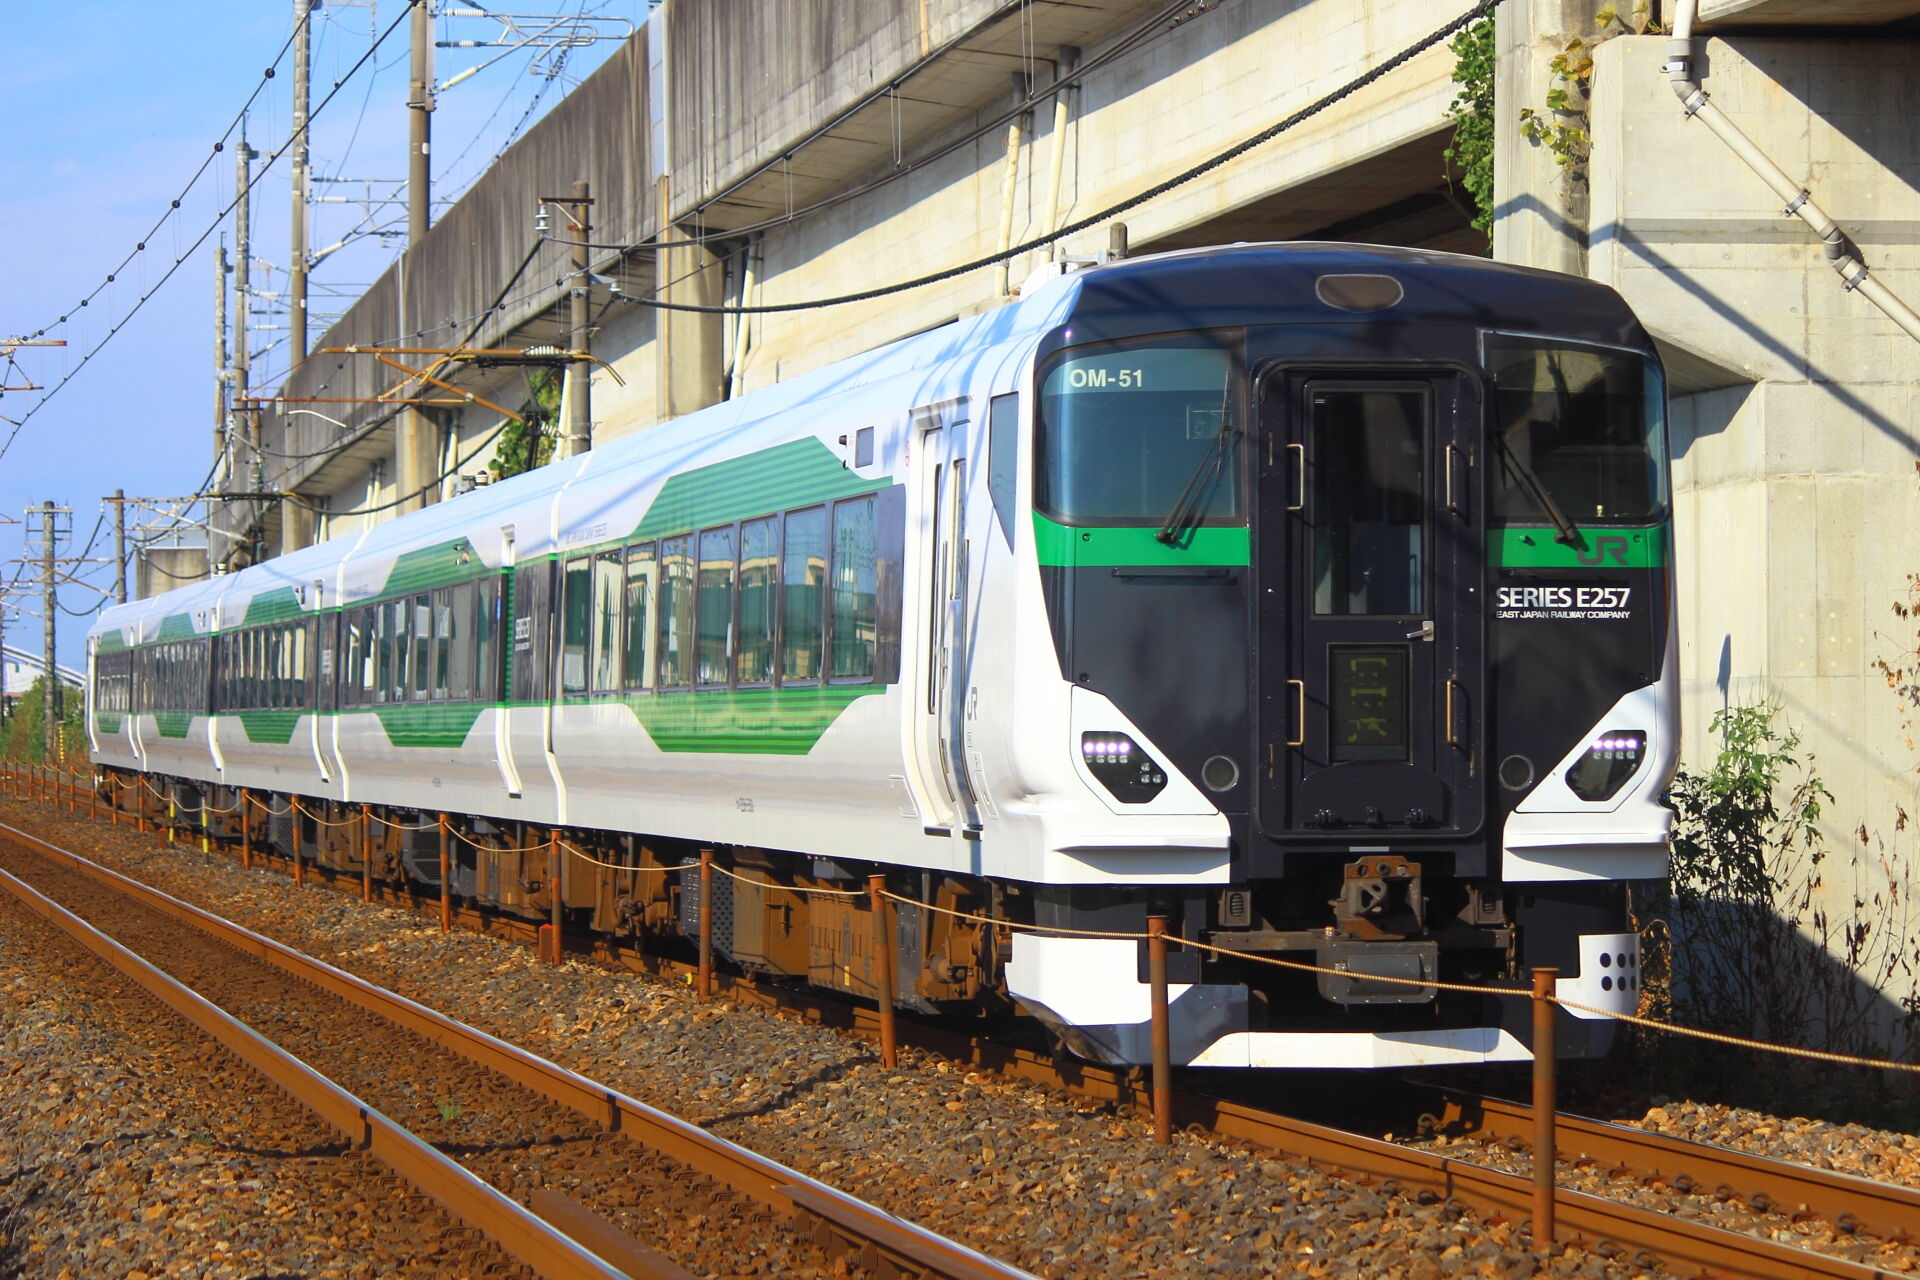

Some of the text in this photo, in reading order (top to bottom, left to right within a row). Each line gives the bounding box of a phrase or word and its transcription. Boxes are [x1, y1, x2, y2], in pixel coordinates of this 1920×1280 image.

[1069, 368, 1142, 388] OM-51
[1577, 537, 1628, 565] JR
[1496, 587, 1630, 608] SERIES E257
[1497, 610, 1630, 619] EAST JAPAN RAILWAY COMPANY
